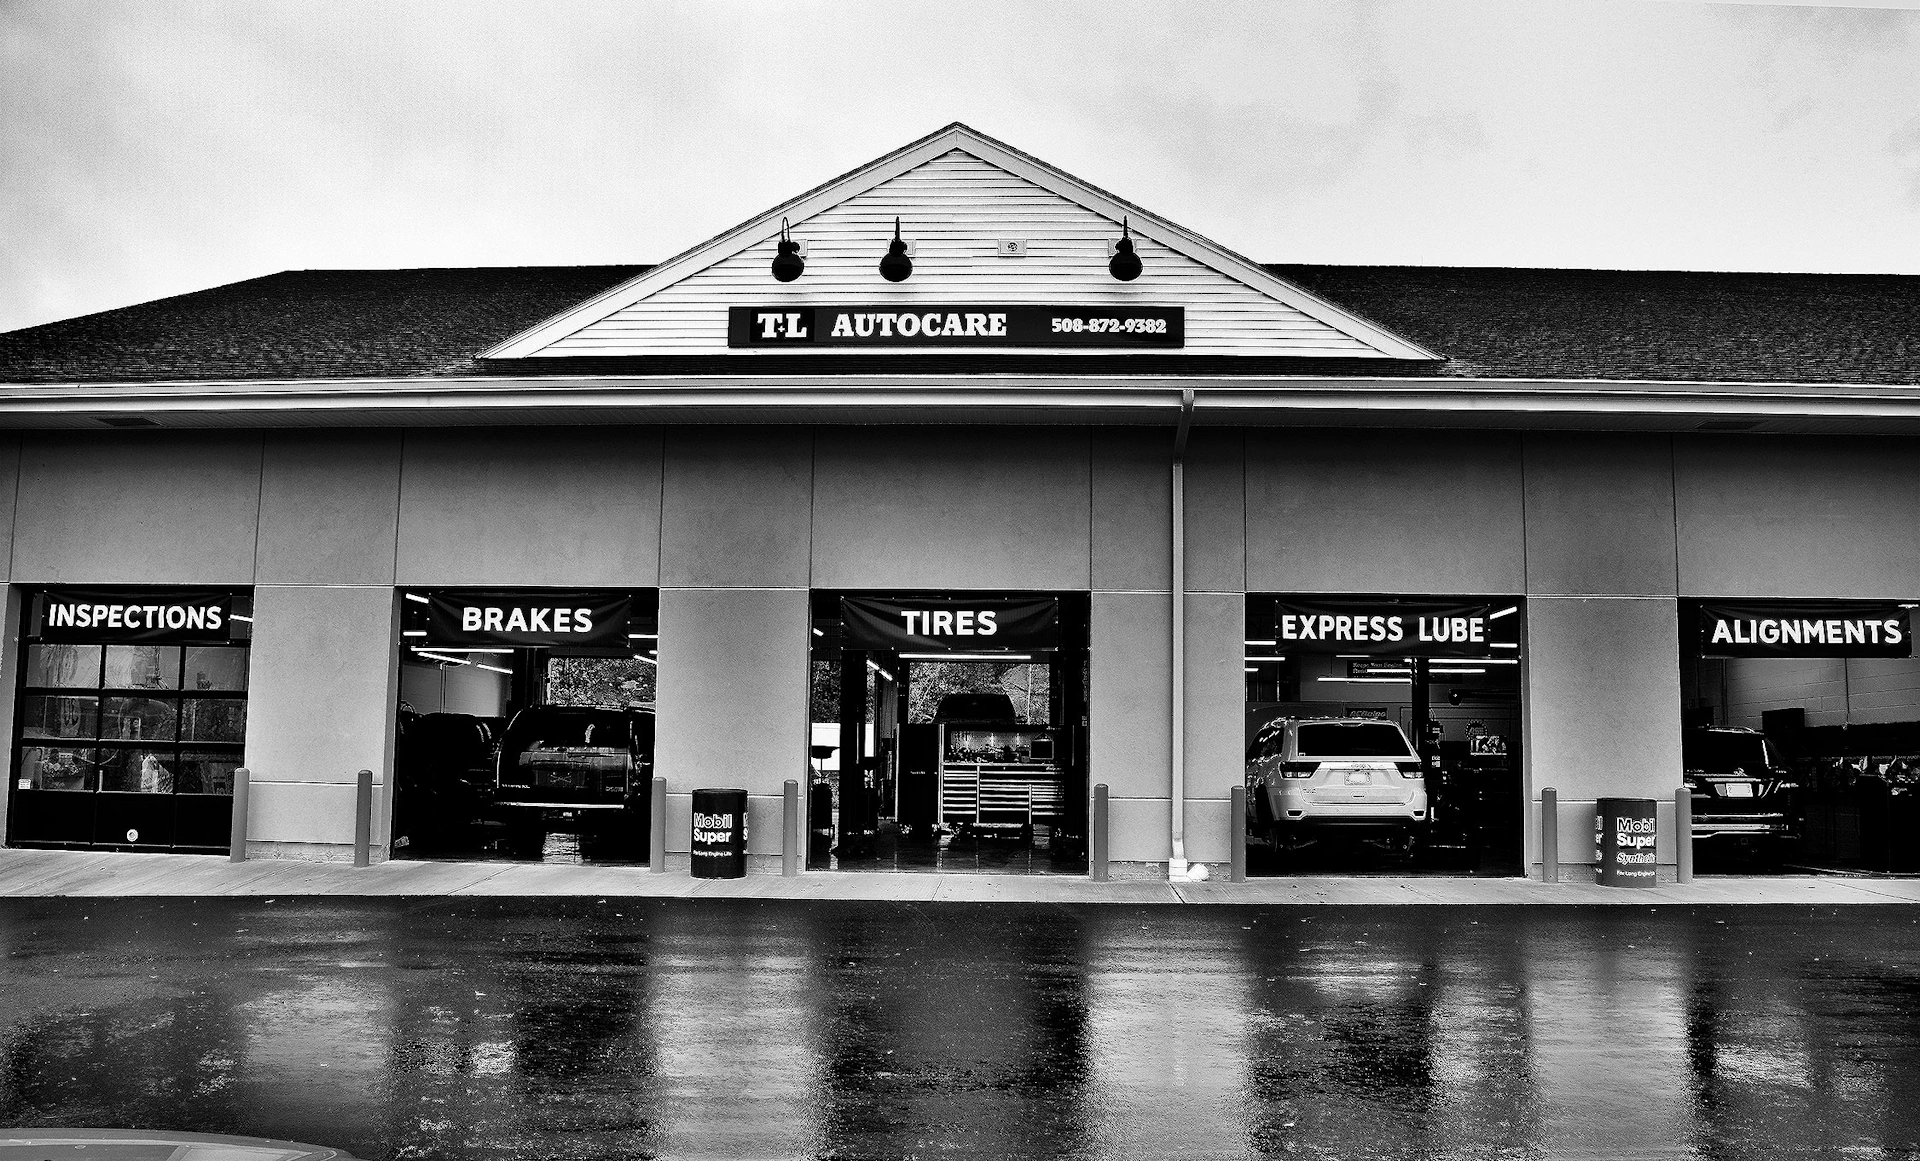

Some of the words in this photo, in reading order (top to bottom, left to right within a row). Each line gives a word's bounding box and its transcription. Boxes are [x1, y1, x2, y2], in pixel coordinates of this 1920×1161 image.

[831, 313, 1007, 337] AUTOCARE
[1051, 318, 1167, 334] 508-872-9382
[48, 603, 223, 631] INSPECTIONS
[462, 606, 594, 634] BRAKES
[900, 610, 998, 636] TIRES
[1282, 614, 1403, 642] EXPRESS
[1418, 616, 1485, 643] LUBE
[1711, 618, 1903, 645] ALIGNMENTS
[694, 812, 732, 828] Mobil
[694, 828, 732, 845] Super
[1617, 833, 1656, 849] Super
